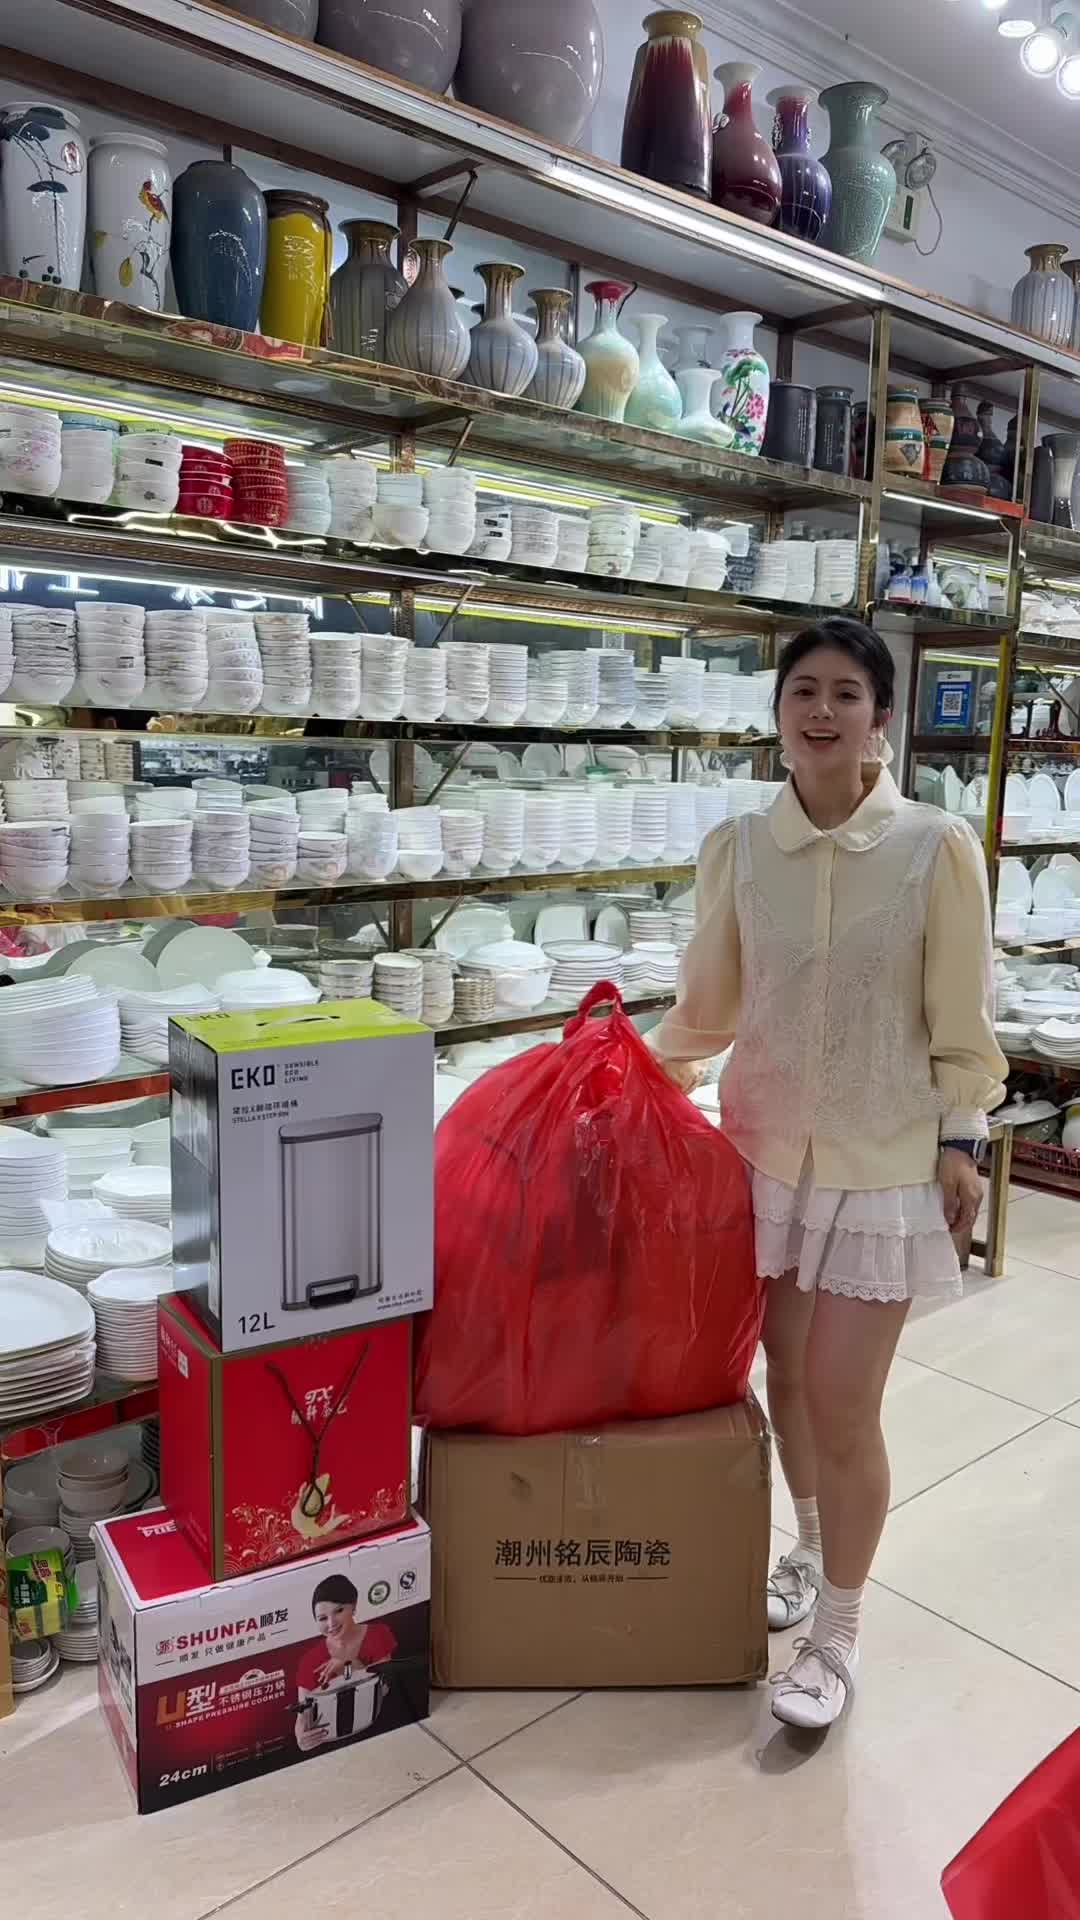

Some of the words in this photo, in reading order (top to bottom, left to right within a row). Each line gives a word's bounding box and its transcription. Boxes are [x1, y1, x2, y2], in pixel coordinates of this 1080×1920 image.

[231, 1065, 276, 1091] EKO
[237, 1311, 276, 1334] 12L
[494, 1539, 672, 1567] 潮州铭辰陶瓷
[176, 1617, 259, 1650] SHUNFA
[260, 1607, 289, 1628] 顺发
[179, 1651, 199, 1664] 顺发
[204, 1632, 267, 1657] 只做健康产品
[205, 1700, 250, 1719] PRESSURE
[251, 1690, 286, 1706] COOKER
[218, 1679, 286, 1708] 不锈钢压力锅
[159, 1763, 209, 1788] 24cm
